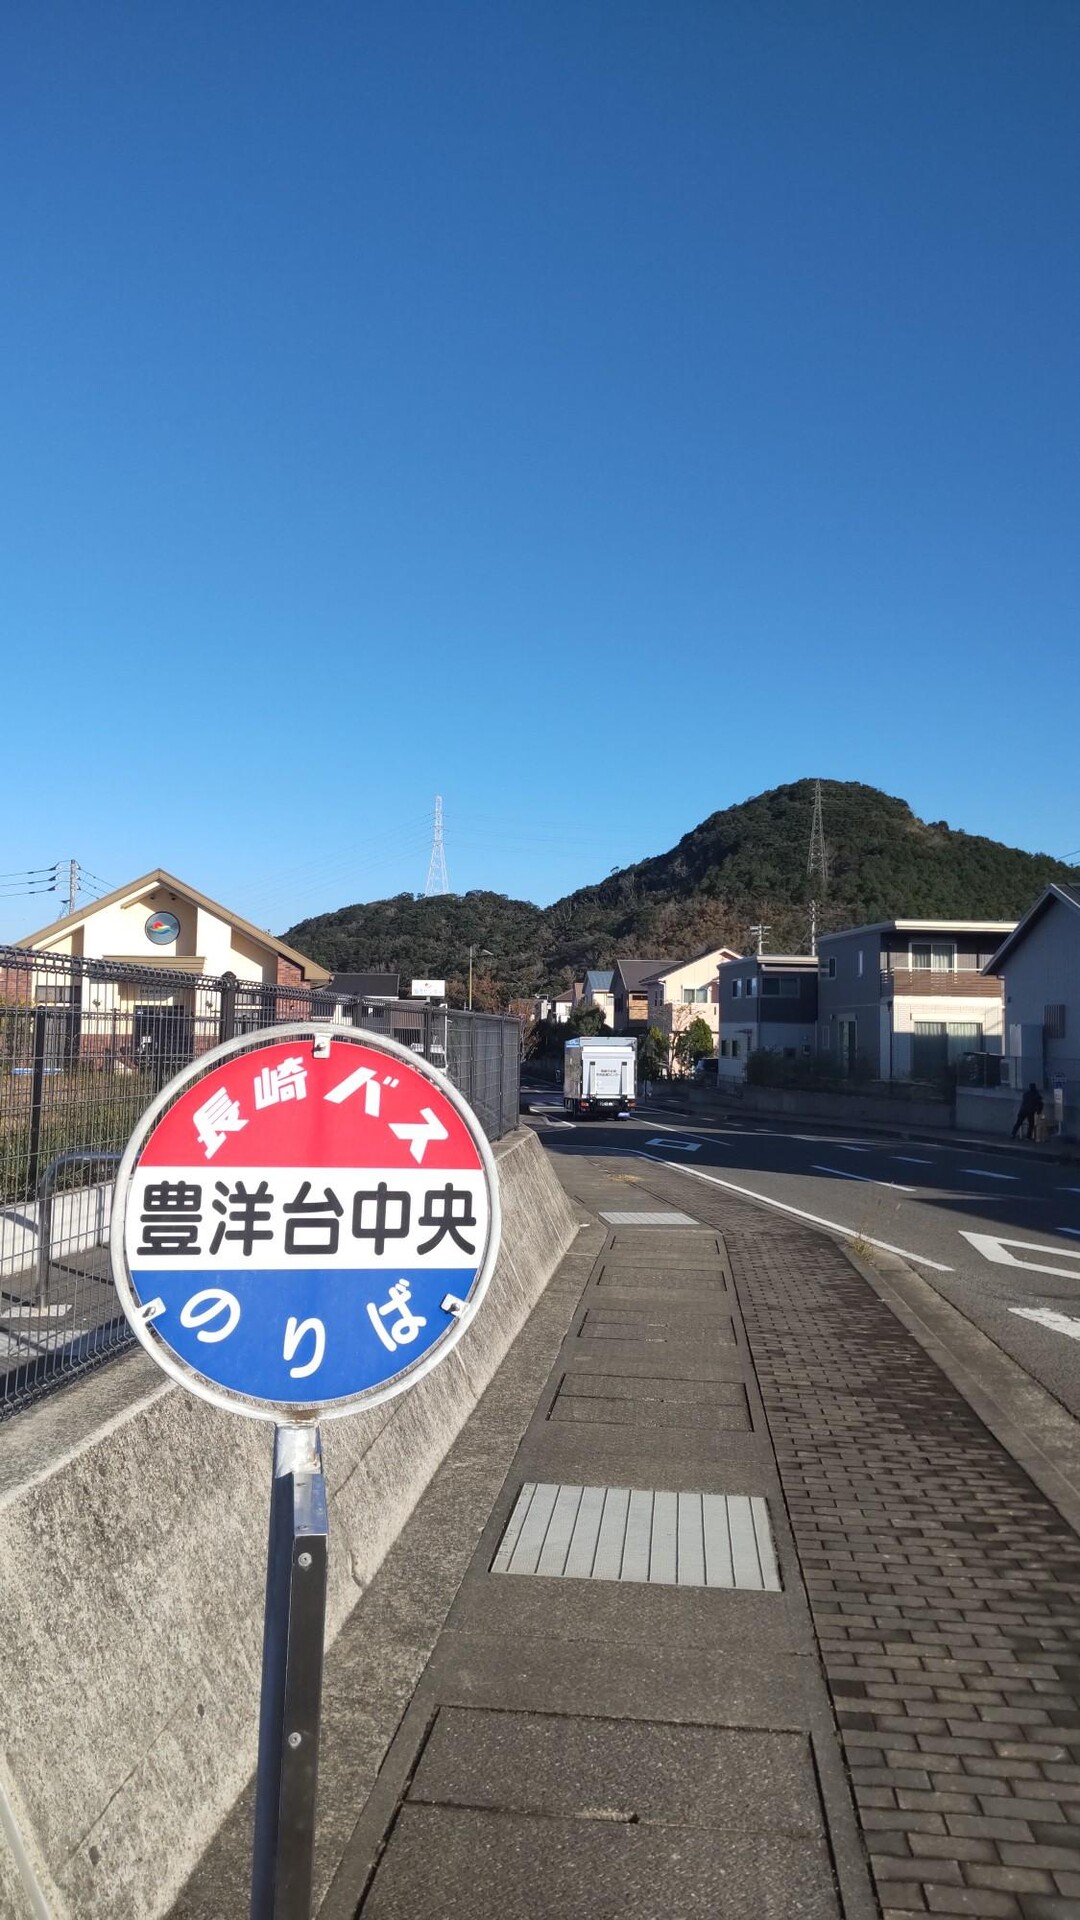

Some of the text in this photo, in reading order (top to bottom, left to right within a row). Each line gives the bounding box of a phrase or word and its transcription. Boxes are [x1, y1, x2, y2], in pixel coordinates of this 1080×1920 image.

[192, 1056, 449, 1164] 長崎バス
[136, 1181, 477, 1256] 豊洋台中央
[180, 1278, 427, 1379] のりば
